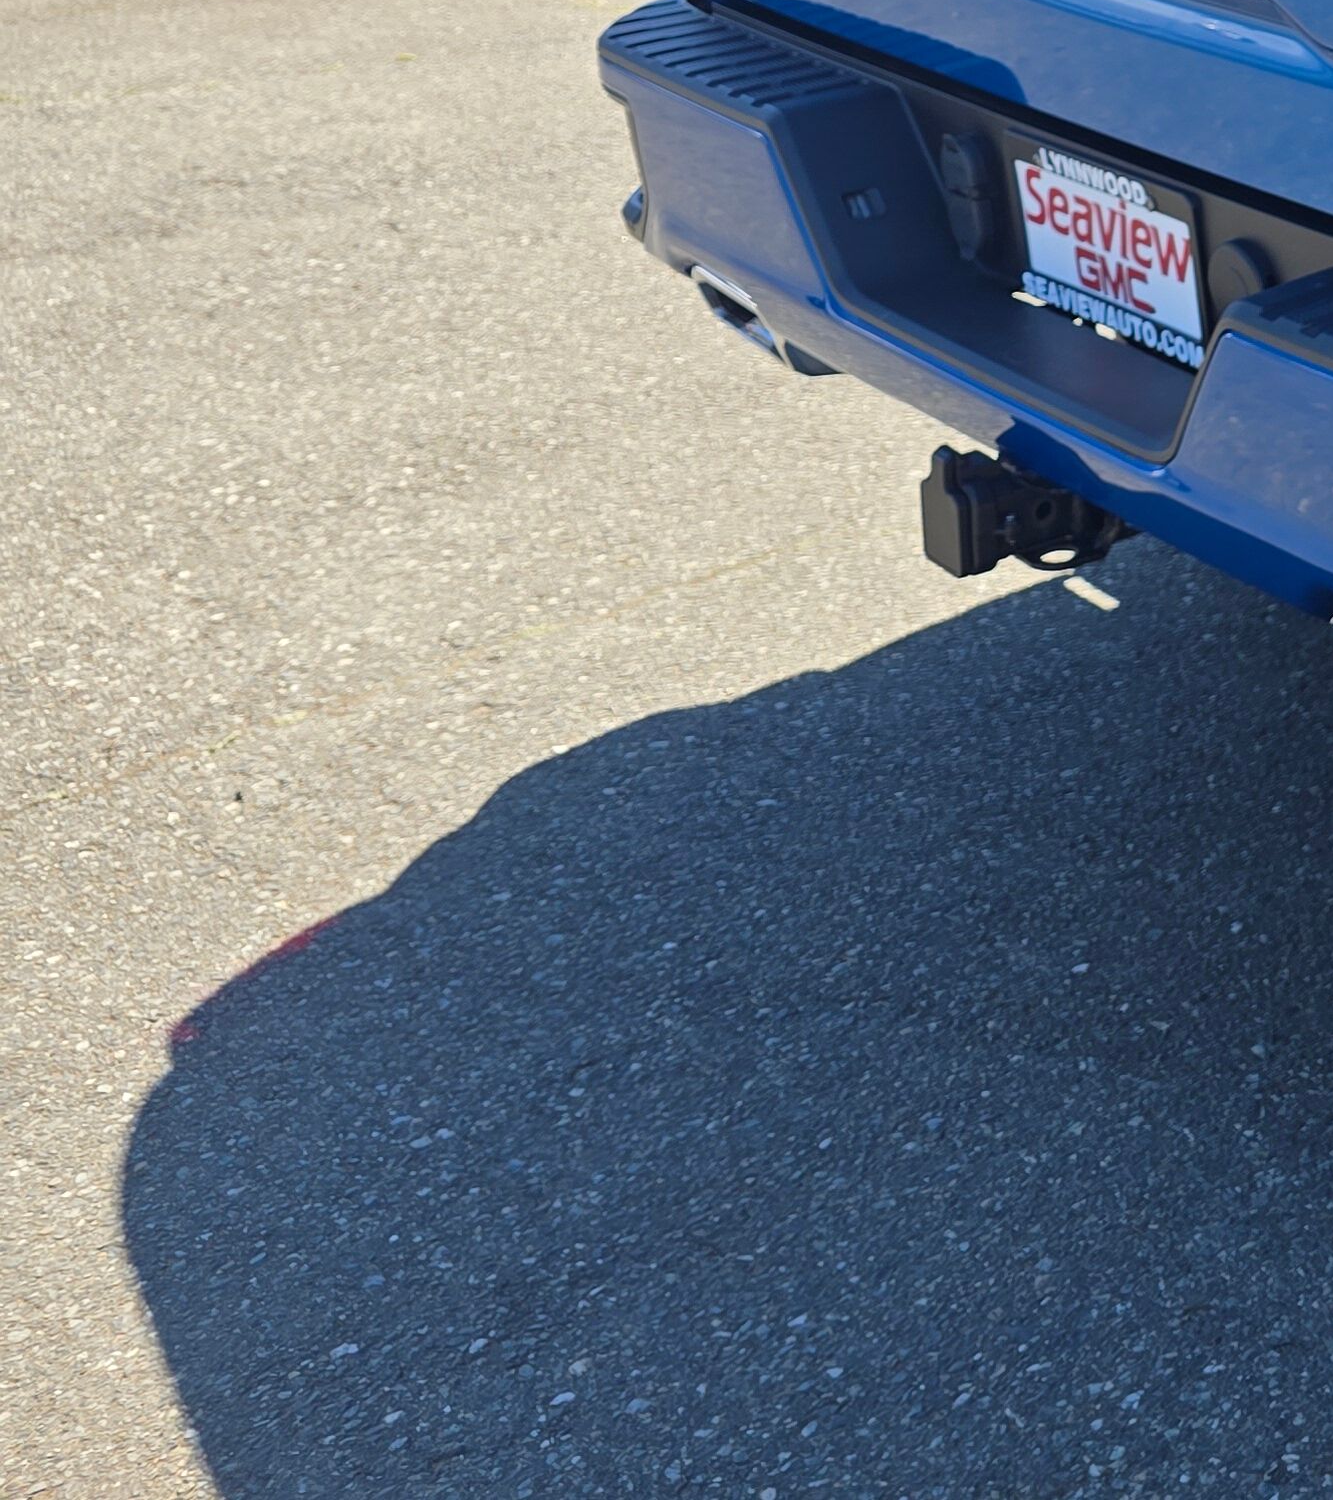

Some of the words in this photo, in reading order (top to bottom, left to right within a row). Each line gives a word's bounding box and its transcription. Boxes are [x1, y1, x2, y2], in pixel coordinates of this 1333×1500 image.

[1037, 147, 1147, 206] LYNNWOOD
[1025, 168, 1191, 283] Seaview
[1021, 271, 1204, 368] SEAVIEWAUTO.COM
[1074, 246, 1156, 314] GMC
